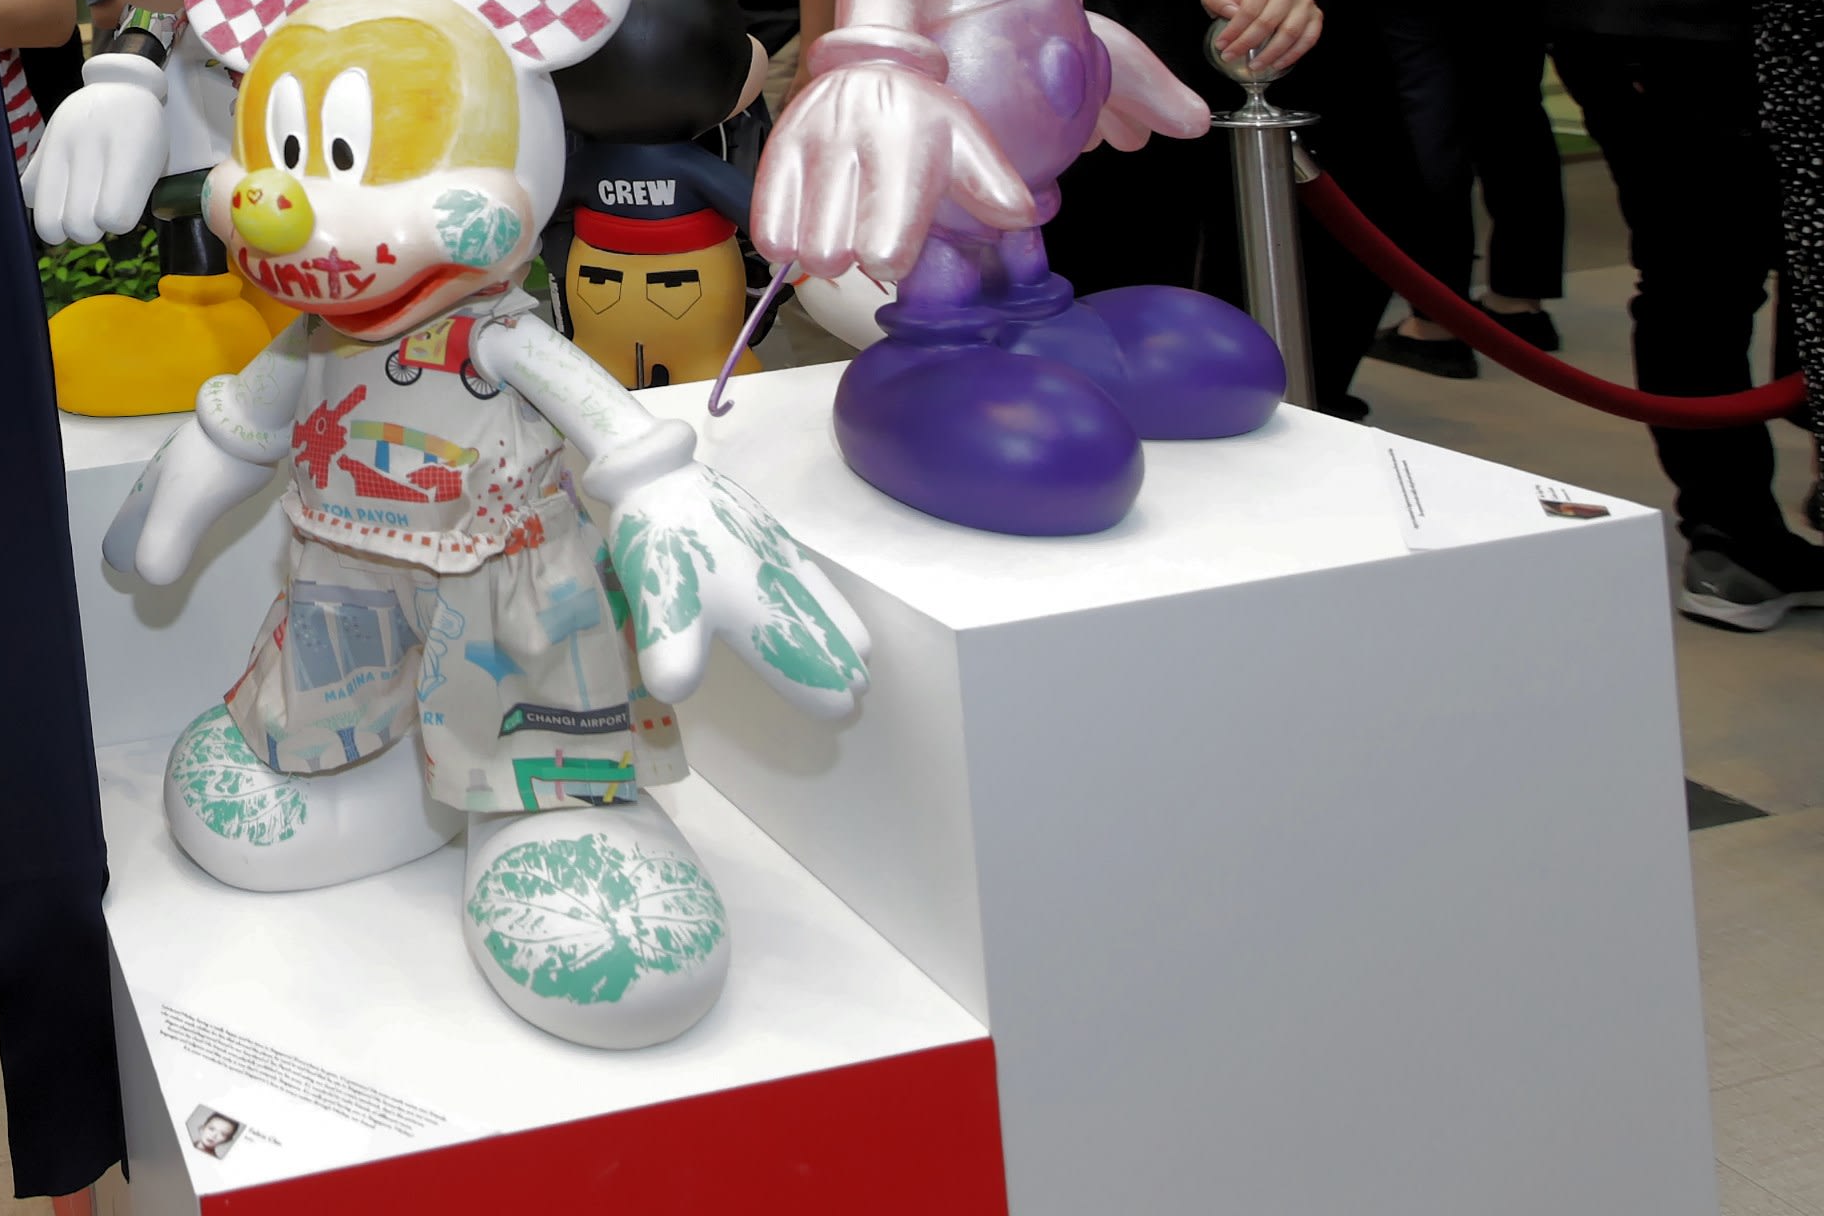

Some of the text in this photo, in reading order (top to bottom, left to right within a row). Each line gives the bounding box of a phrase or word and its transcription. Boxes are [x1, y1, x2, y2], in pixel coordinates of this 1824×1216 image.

[598, 179, 676, 206] CREW
[356, 507, 409, 527] PAYOH
[324, 670, 376, 703] MARINA
[526, 712, 627, 729] CHANGI AIRPORT
